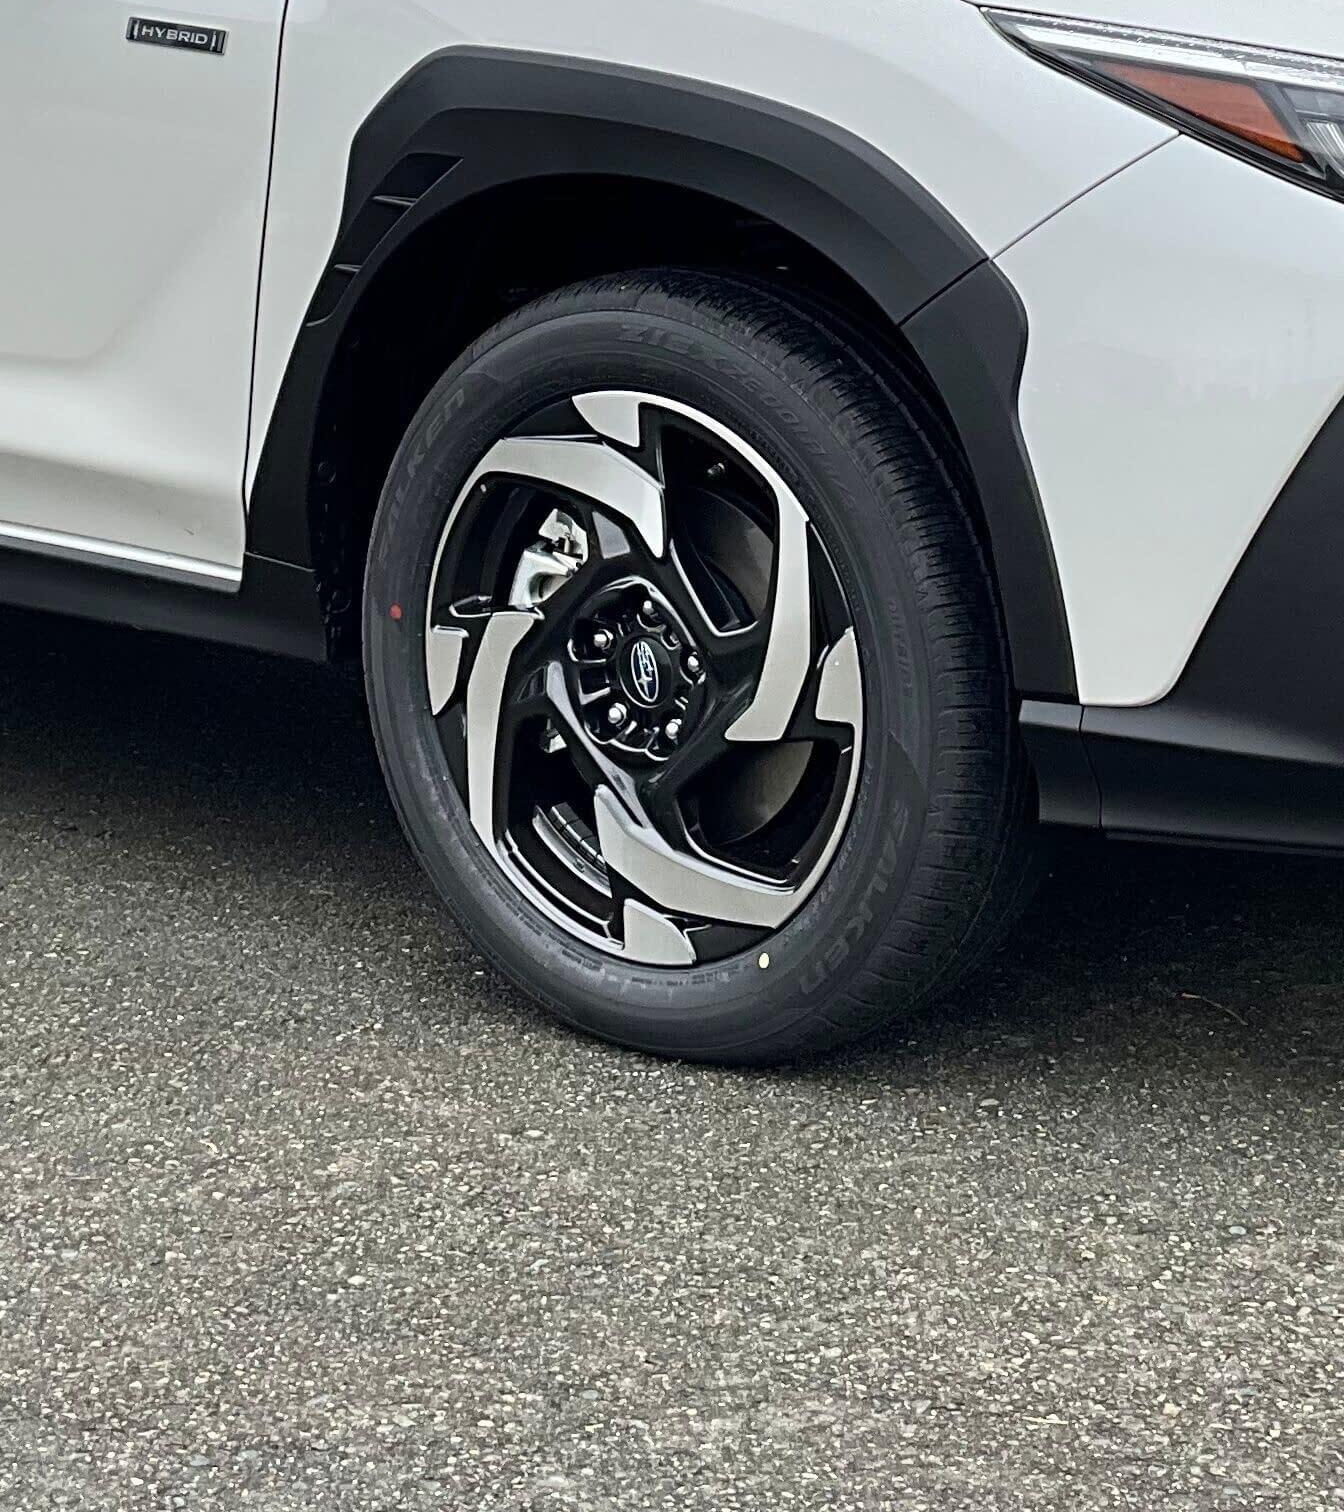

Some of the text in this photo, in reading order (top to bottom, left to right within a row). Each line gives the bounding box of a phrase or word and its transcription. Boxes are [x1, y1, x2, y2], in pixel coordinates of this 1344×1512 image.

[141, 25, 208, 45] HYBRID
[378, 387, 465, 570] FALKEN
[799, 799, 910, 994] FALKEN
